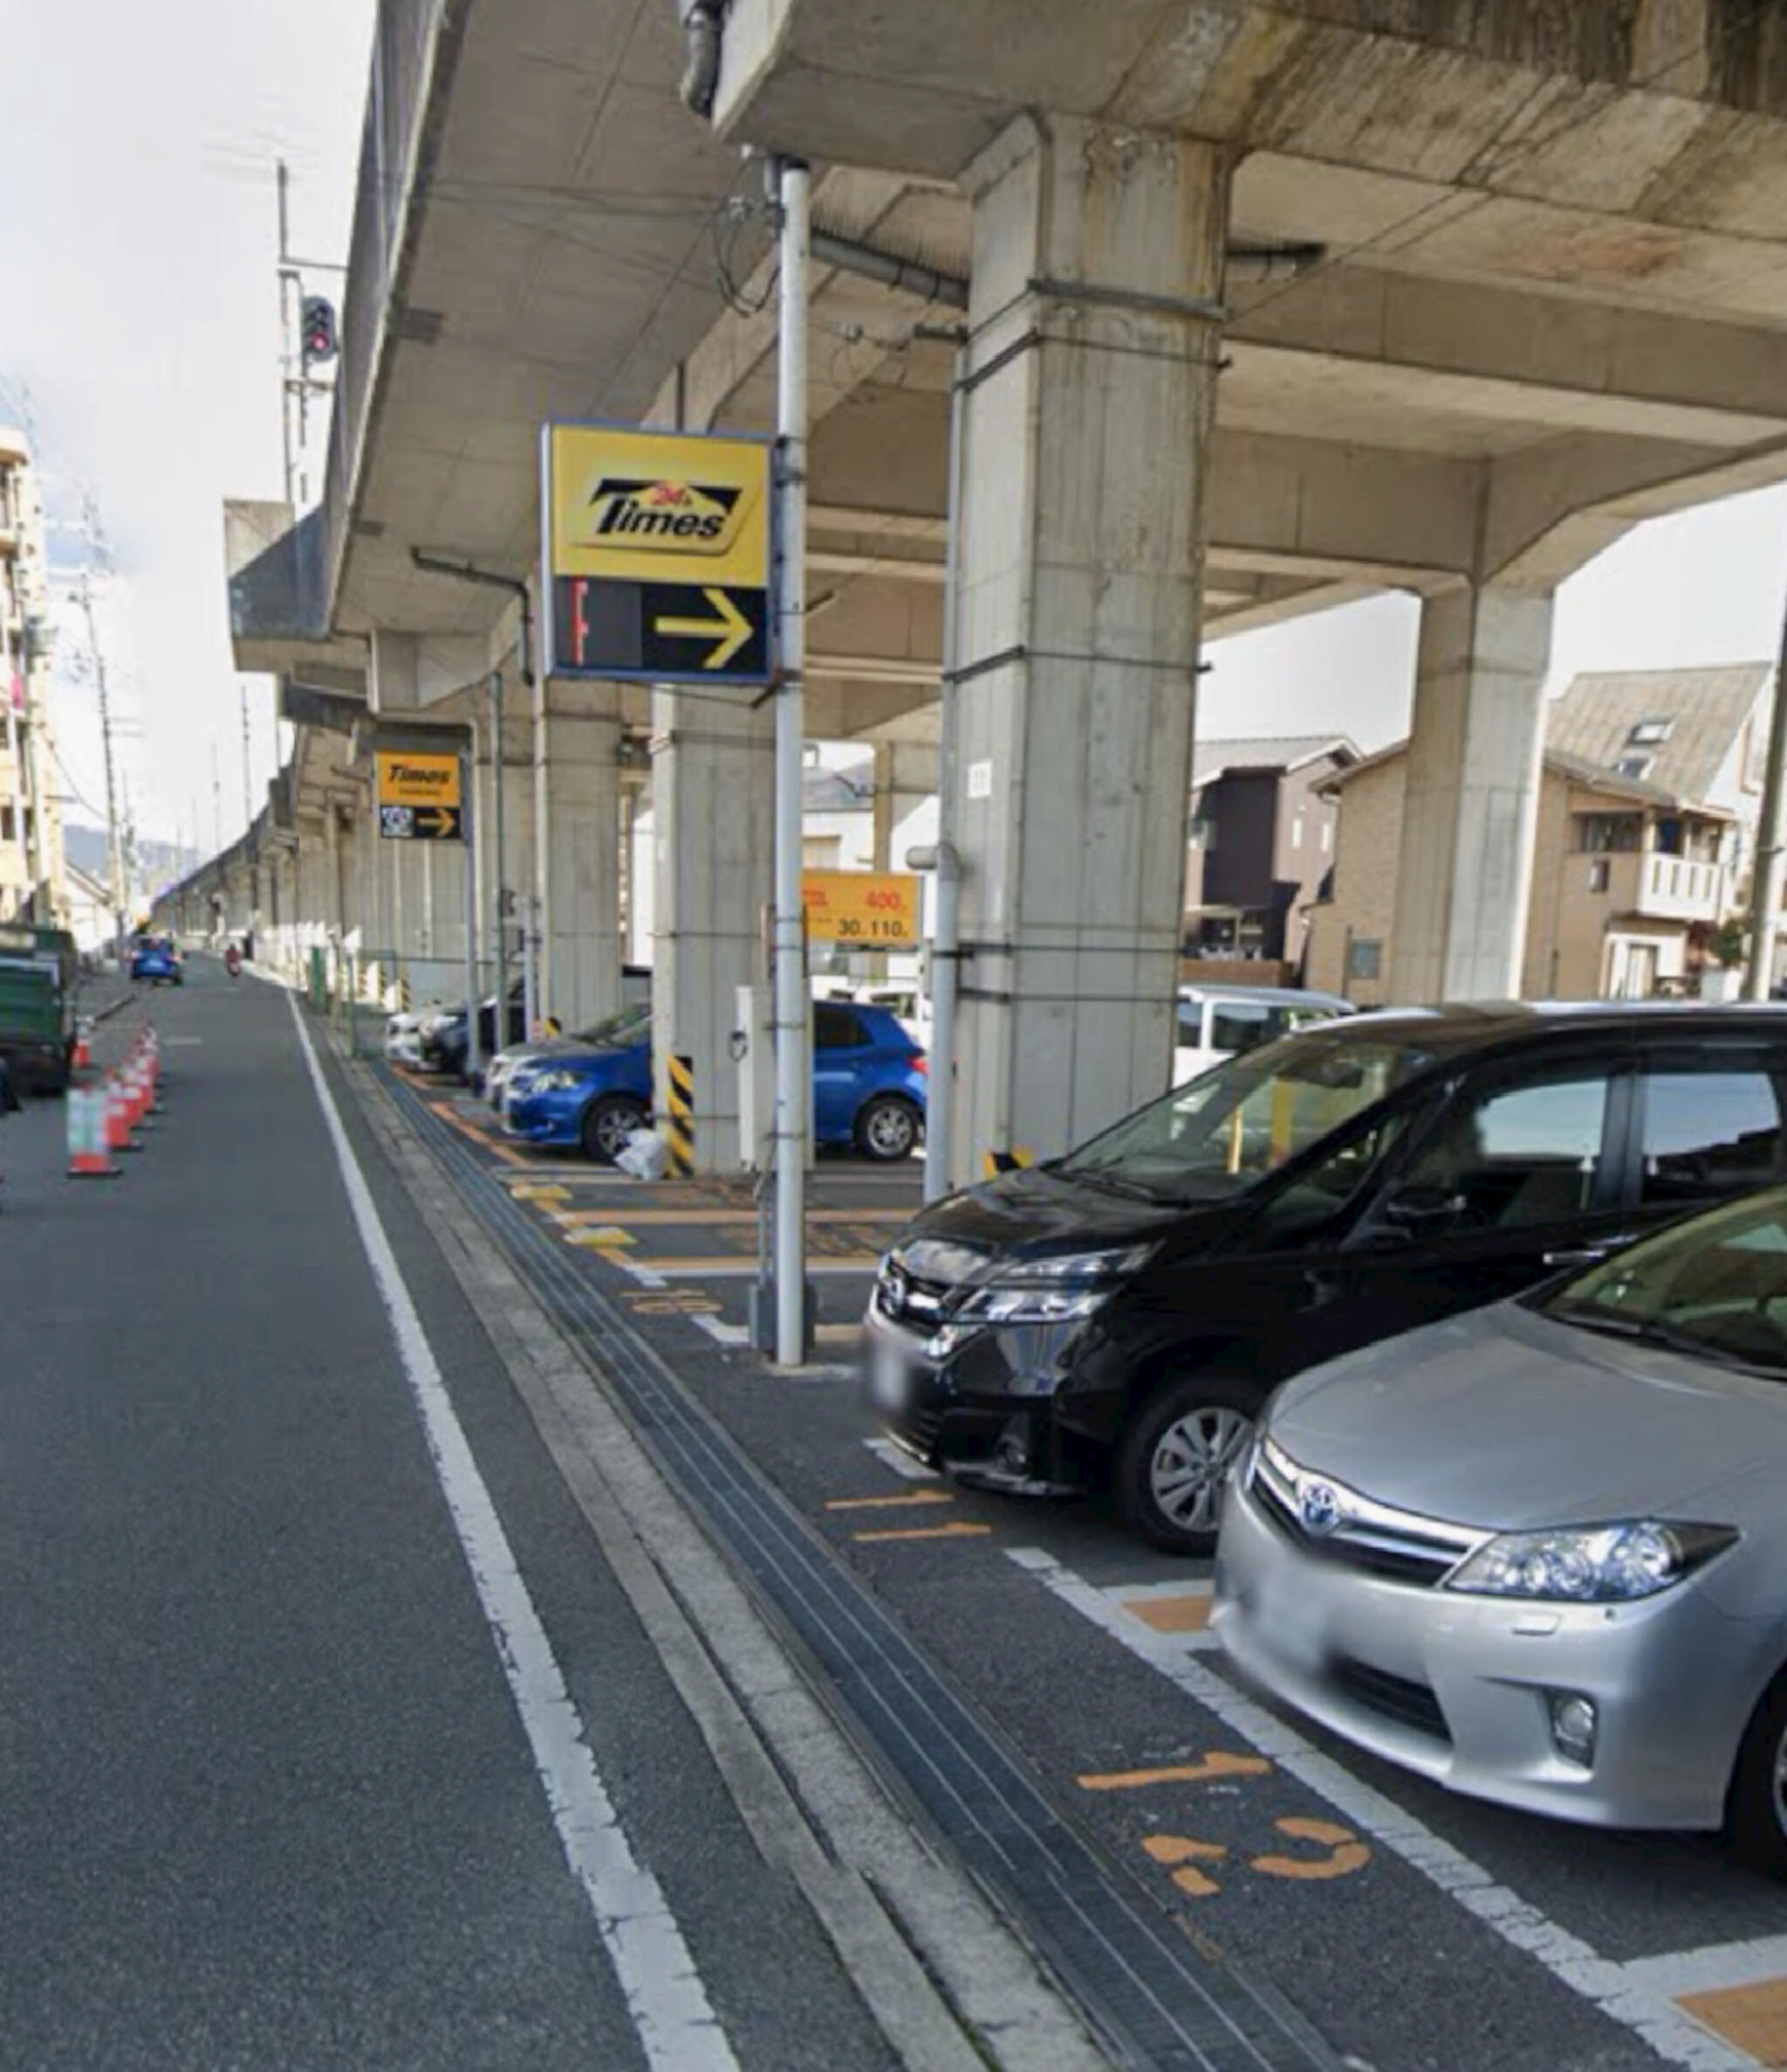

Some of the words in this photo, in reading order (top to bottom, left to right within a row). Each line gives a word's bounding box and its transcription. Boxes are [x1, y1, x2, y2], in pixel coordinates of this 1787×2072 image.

[589, 479, 742, 539] Times
[389, 763, 450, 785] Times
[1077, 1751, 1371, 1896] 12
